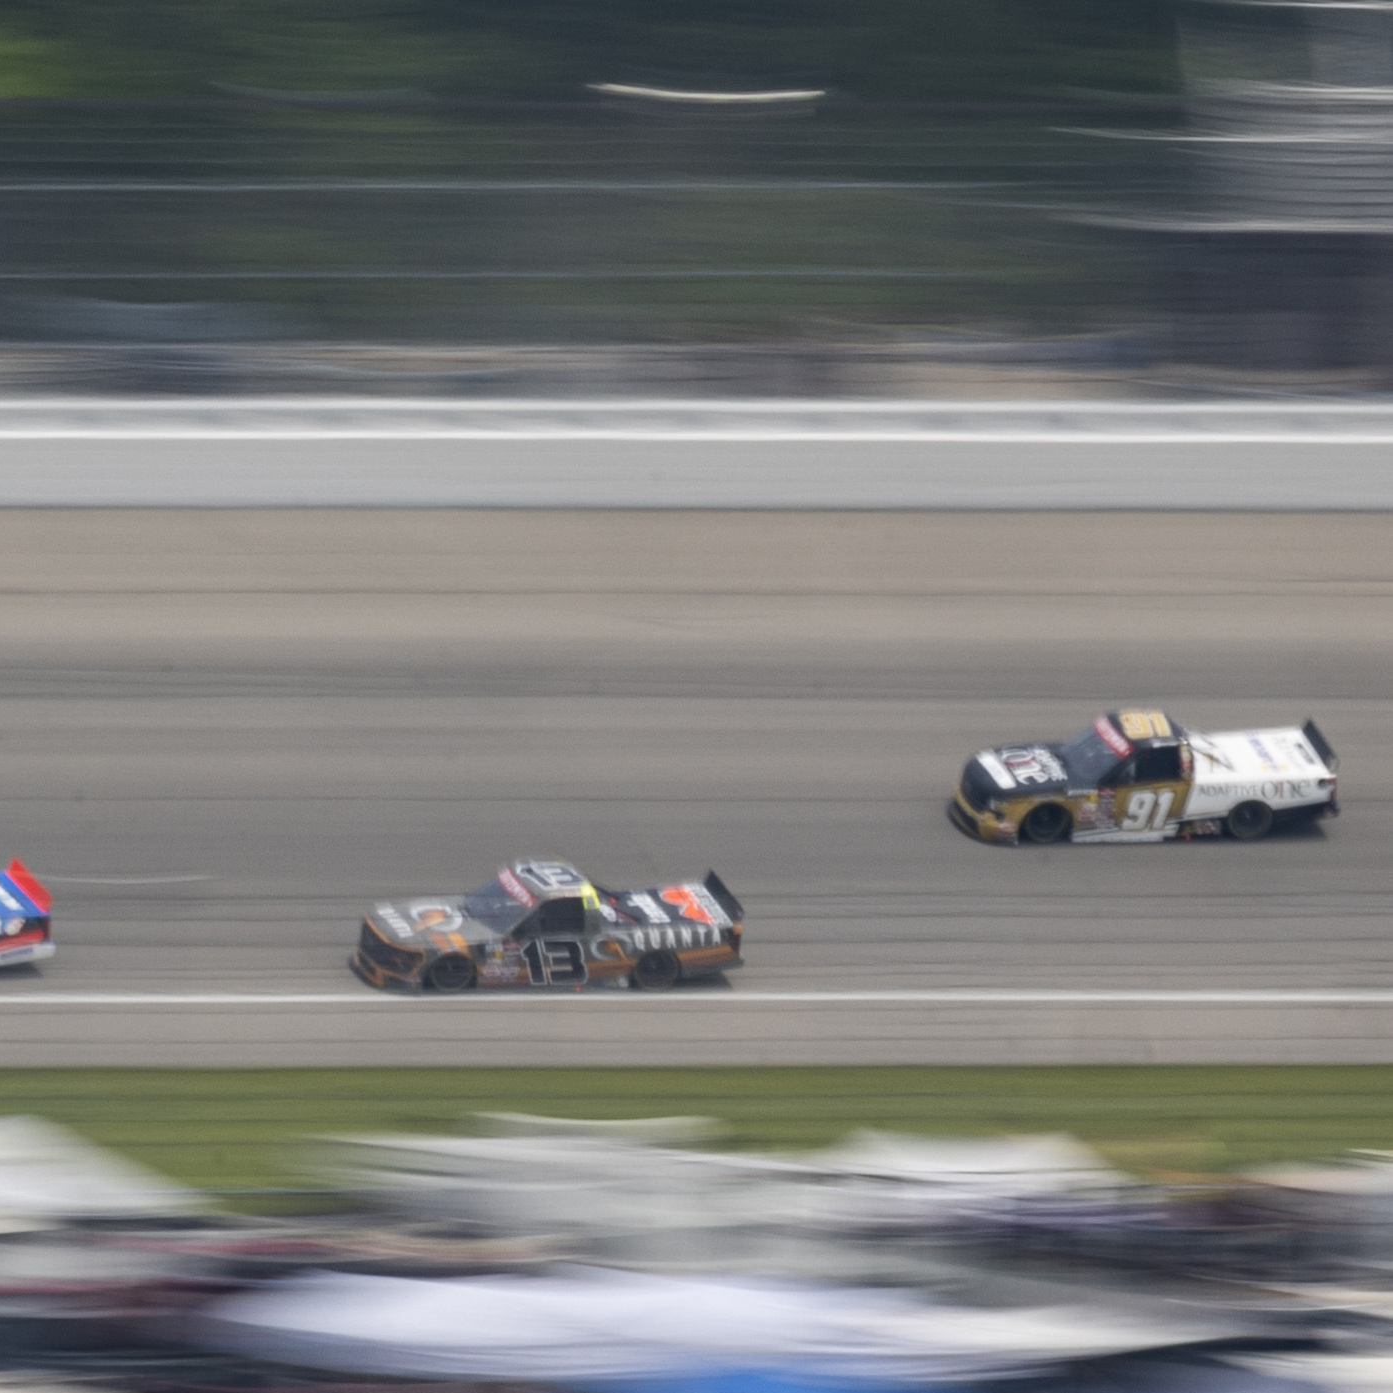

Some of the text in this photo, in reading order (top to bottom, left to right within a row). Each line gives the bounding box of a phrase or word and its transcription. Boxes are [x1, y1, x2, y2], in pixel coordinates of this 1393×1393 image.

[1198, 782, 1259, 798] ADAPTIVE
[1121, 788, 1175, 832] 91
[516, 862, 583, 891] 13
[633, 925, 722, 950] QUANTA
[520, 938, 589, 985] 13
